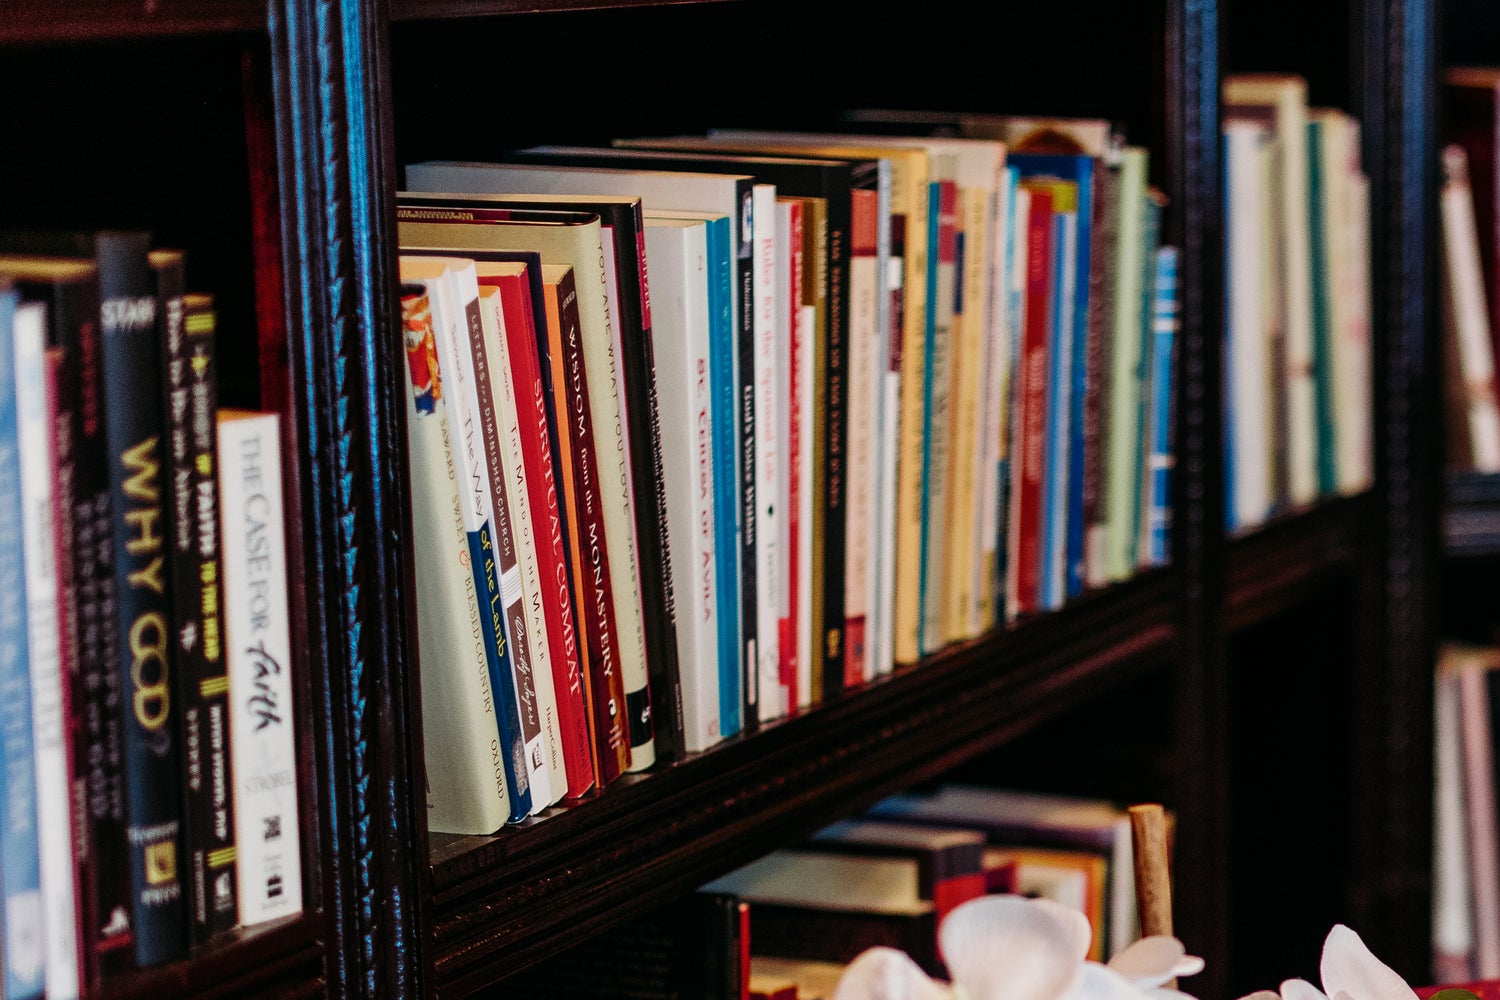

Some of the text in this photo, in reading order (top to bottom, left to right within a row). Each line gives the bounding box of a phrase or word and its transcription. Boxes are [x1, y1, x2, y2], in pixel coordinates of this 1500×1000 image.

[118, 434, 168, 601] WHY
[195, 479, 216, 558] FAITH
[460, 414, 508, 659] The Way of the Lamb
[469, 313, 512, 558] LETTERS DIMINISHED CHURCH
[507, 420, 548, 663] THE MIND OF THE MAKER
[529, 375, 582, 700] SPIRITUAL COMBAT
[564, 325, 617, 680] WISDOM from the MONASTERY
[617, 453, 632, 515] LOVE
[238, 432, 284, 733] THE CASE FOR faith
[439, 416, 456, 483] SAWARD
[450, 493, 466, 547] SWEET
[462, 574, 482, 641] BLESSED
[472, 639, 493, 717] COUNTRY
[489, 737, 506, 801] OXFORD
